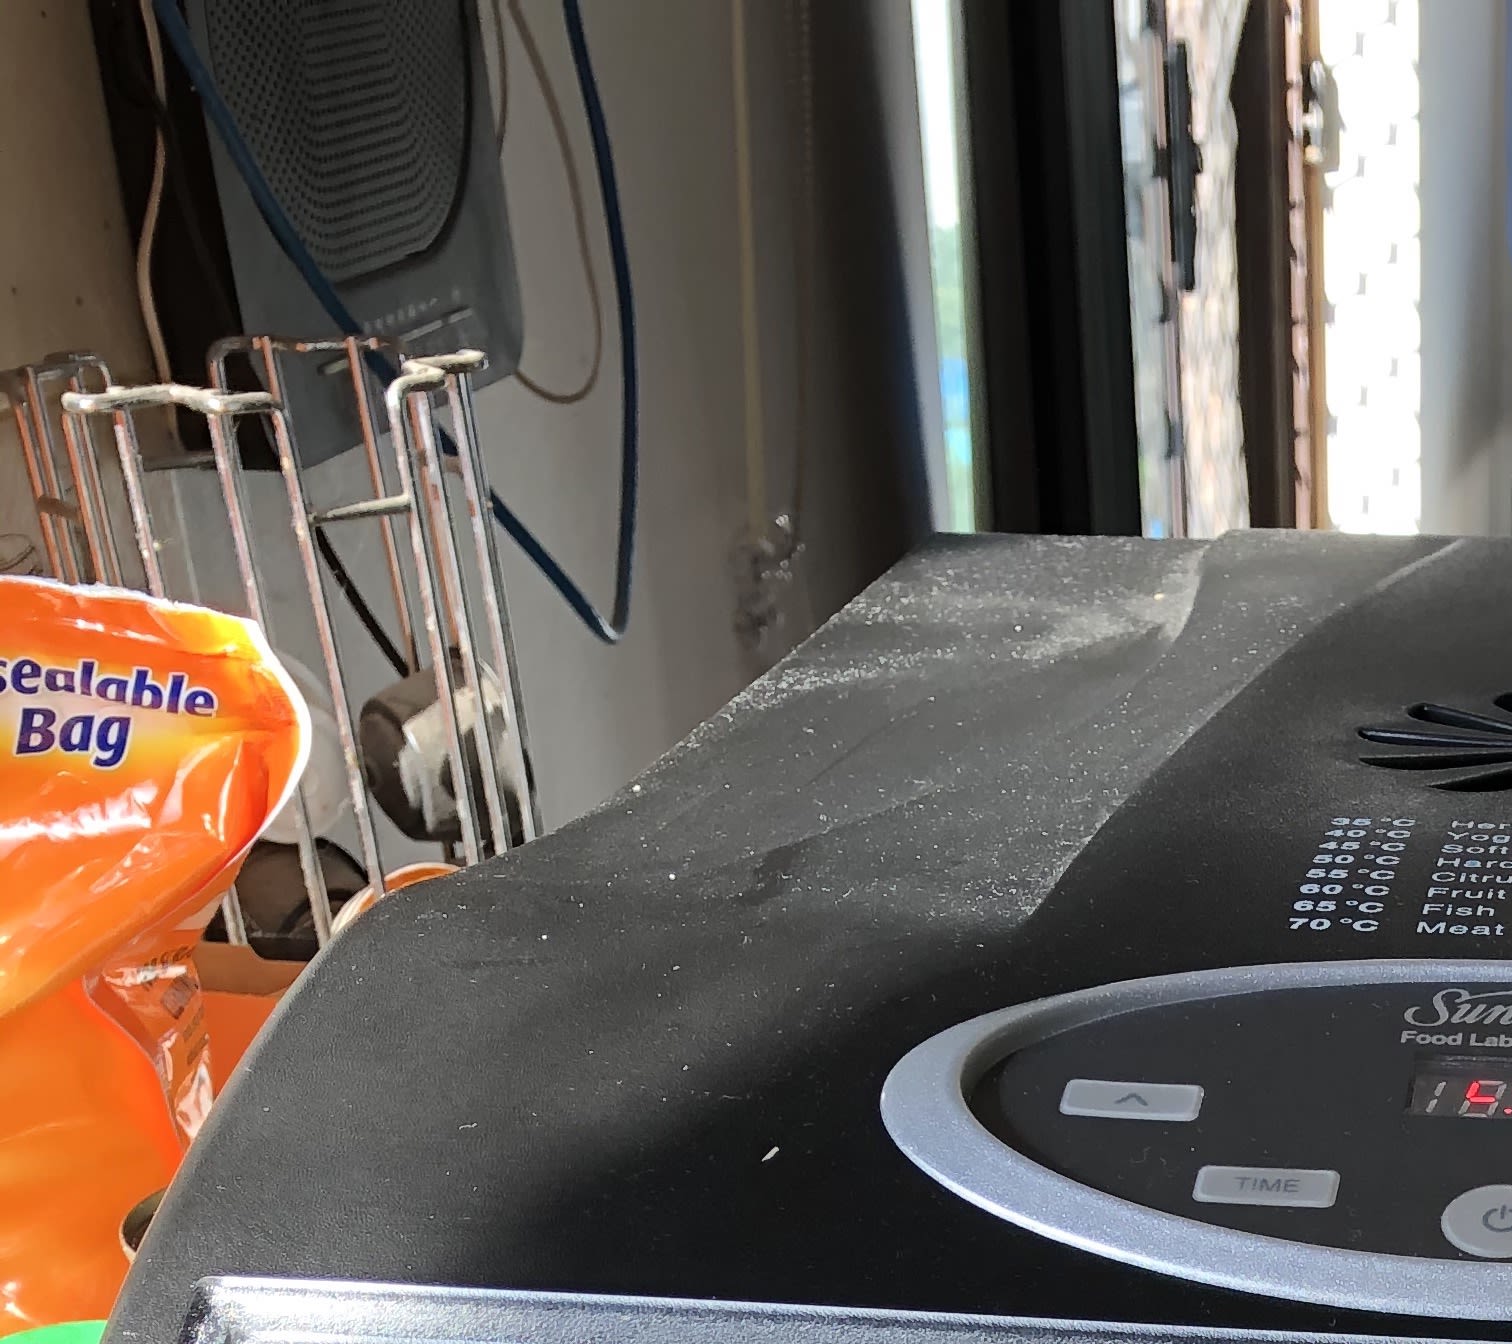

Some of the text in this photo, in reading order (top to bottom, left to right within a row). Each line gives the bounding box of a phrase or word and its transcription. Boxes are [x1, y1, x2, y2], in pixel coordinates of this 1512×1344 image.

[15, 707, 131, 767] Bag
[1324, 828, 1411, 838] 40 °C
[1318, 840, 1406, 851] 45 °C
[1441, 844, 1509, 854] Soft
[1312, 854, 1401, 865] 50 °C
[1306, 868, 1396, 880] 55 °C
[1299, 883, 1391, 896] 60 °C
[1427, 886, 1507, 899] Fruit
[1293, 900, 1385, 913] 65 °C
[1422, 903, 1495, 917] Fish
[1288, 917, 1379, 932] 70 °C
[1416, 921, 1505, 936] Meat
[1400, 1030, 1463, 1046] Food
[1234, 1176, 1301, 1193] TIME
